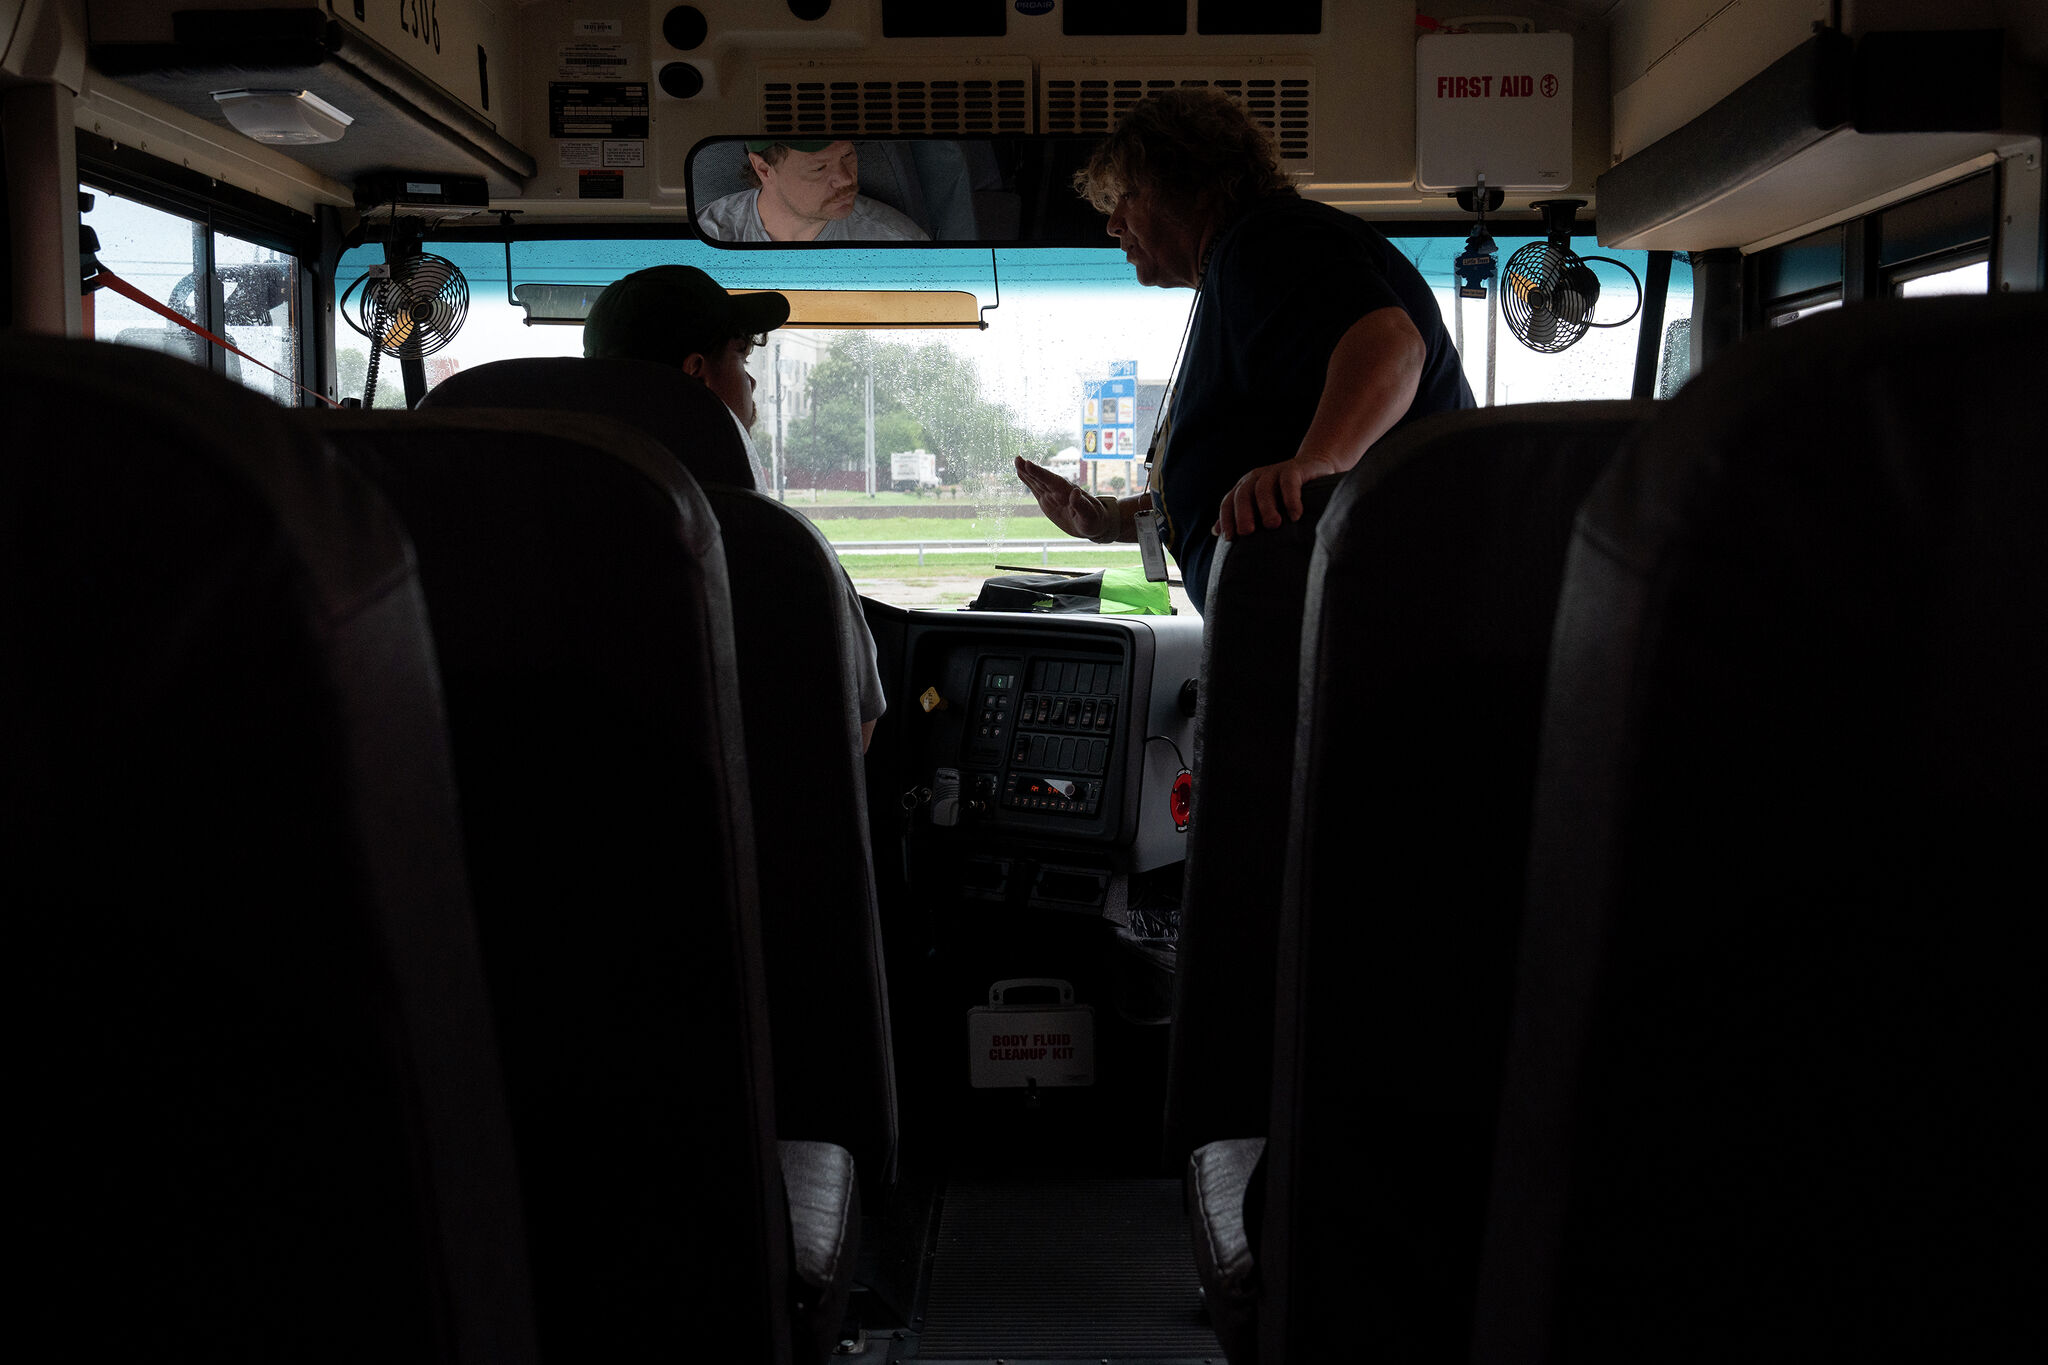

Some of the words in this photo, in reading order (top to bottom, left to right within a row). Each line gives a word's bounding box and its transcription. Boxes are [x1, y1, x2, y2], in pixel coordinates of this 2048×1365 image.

[1016, 1, 1053, 9] PROAIR
[1437, 76, 1492, 98] FIRST
[1500, 75, 1533, 97] AID
[992, 1034, 1028, 1047] BODY
[1033, 1033, 1071, 1046] FLUID
[989, 1048, 1047, 1061] CLEANUP
[1053, 1047, 1075, 1060] KIT
